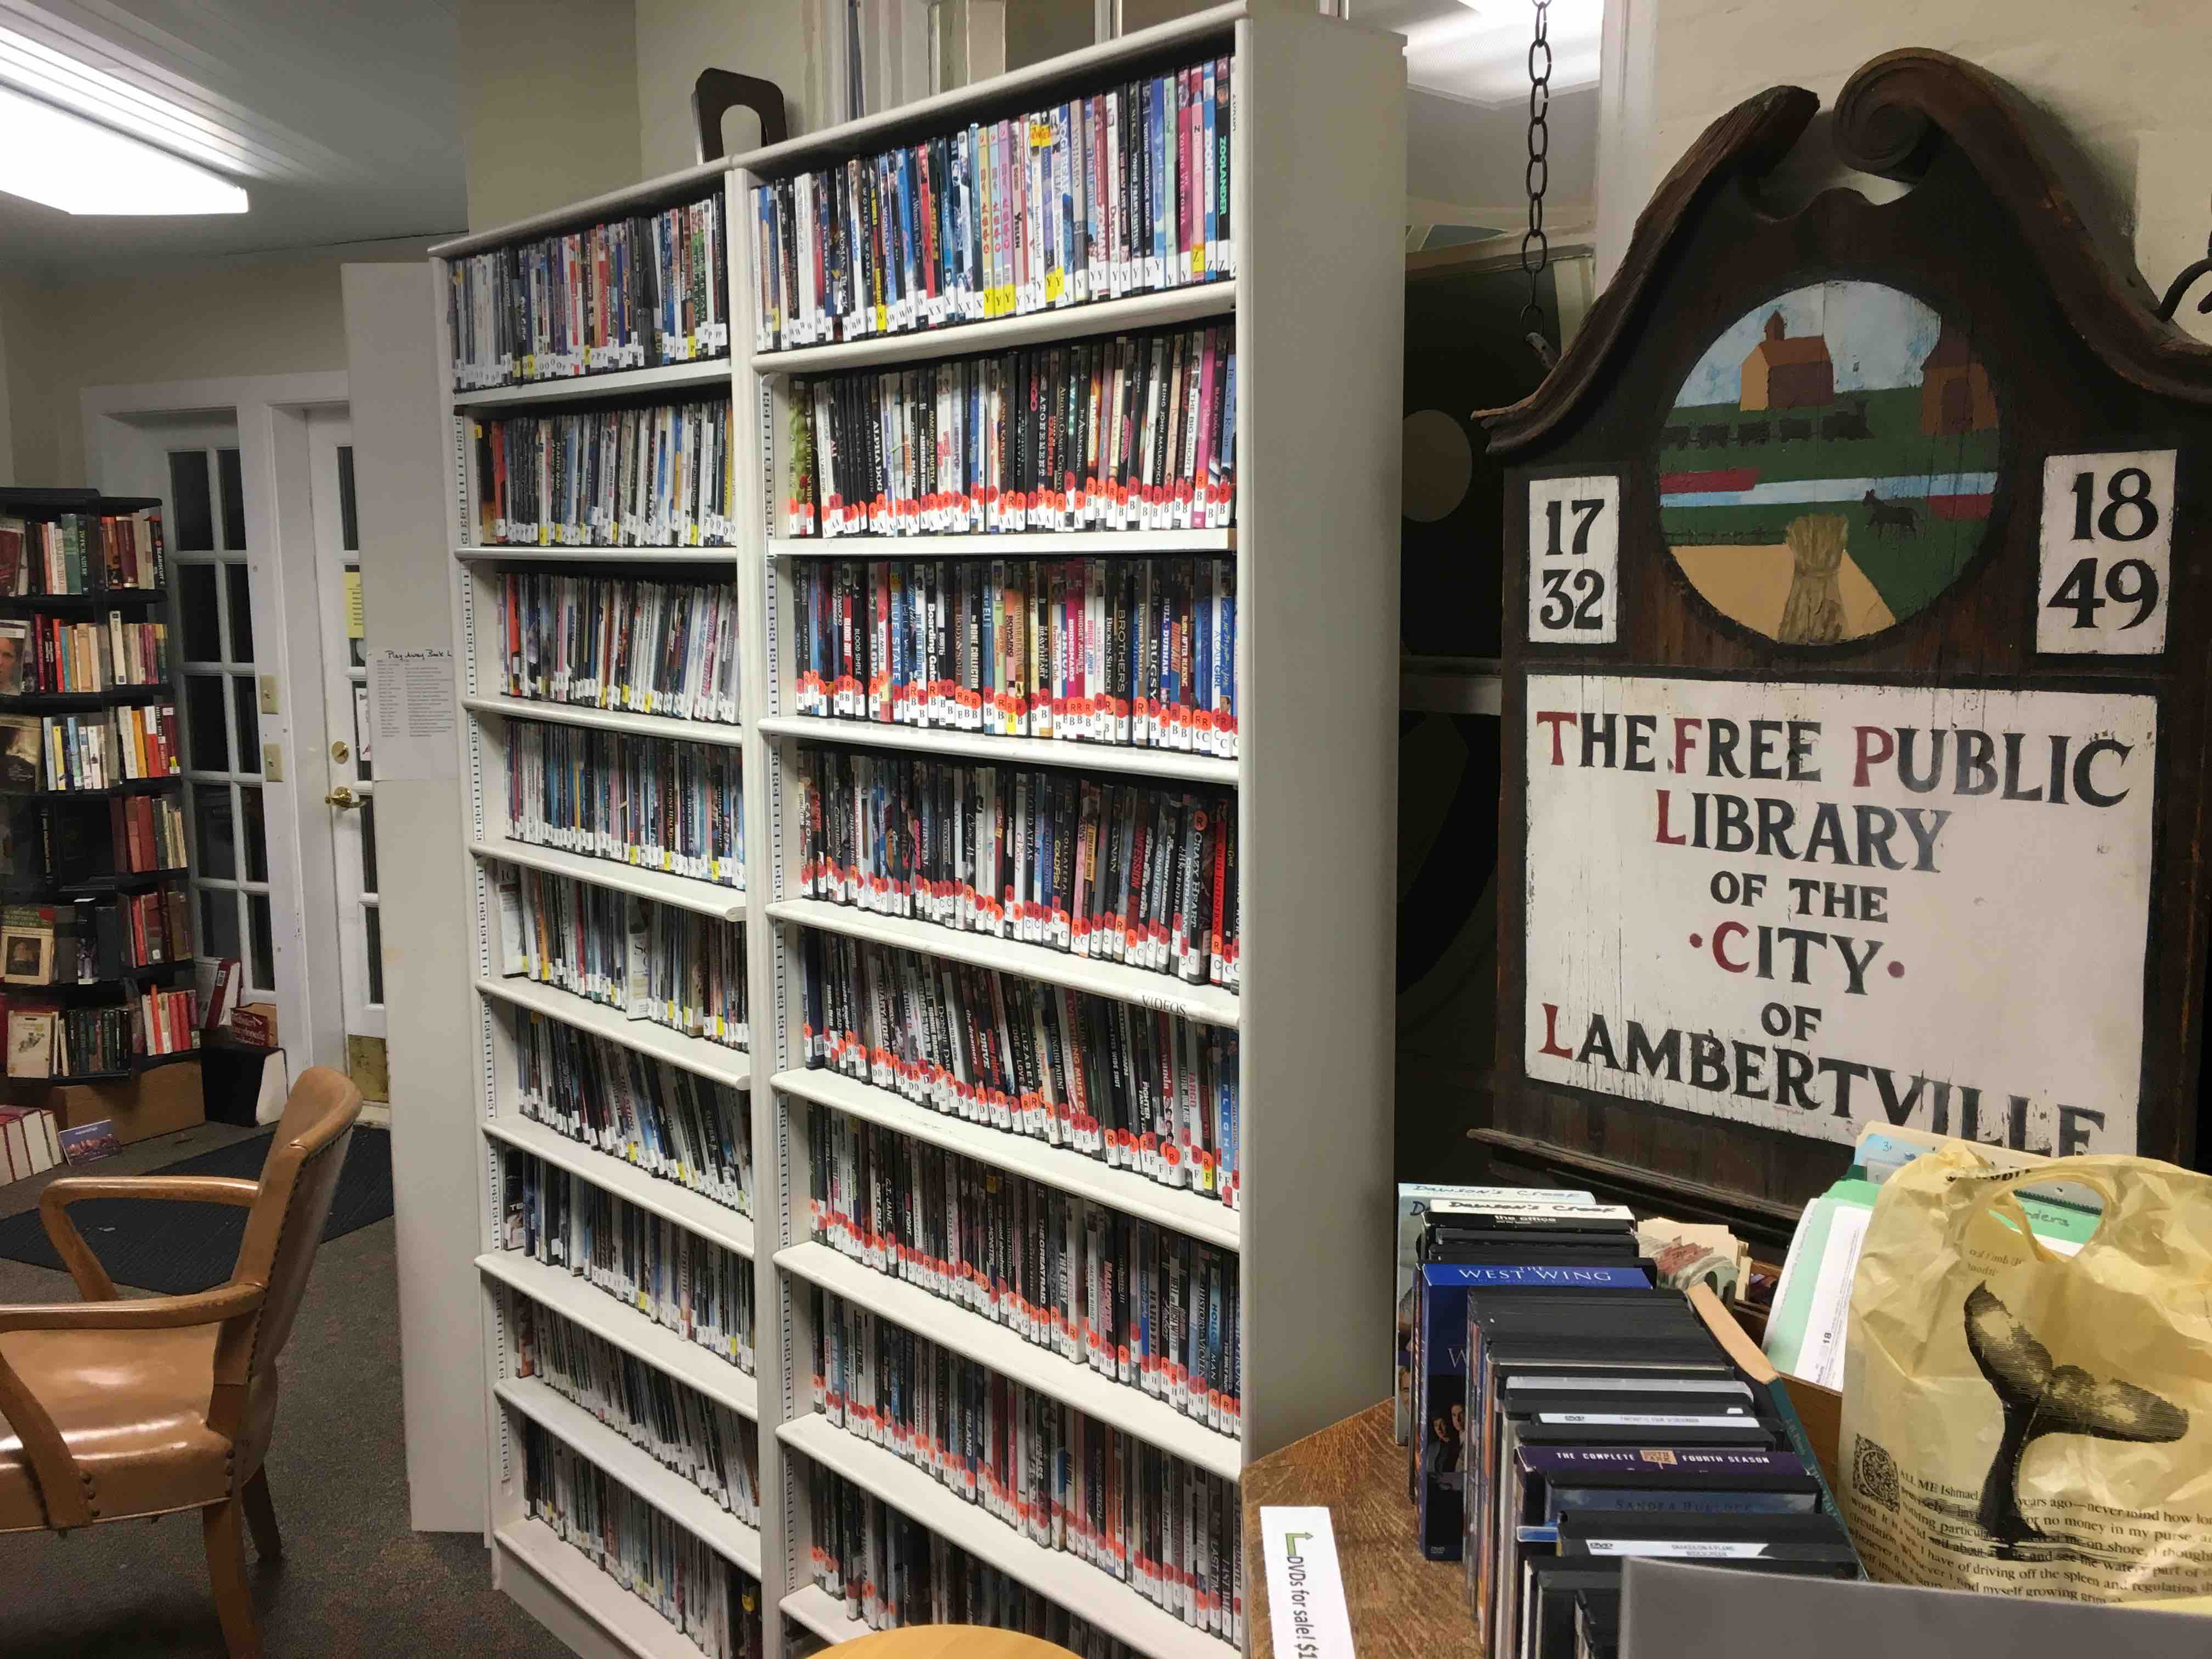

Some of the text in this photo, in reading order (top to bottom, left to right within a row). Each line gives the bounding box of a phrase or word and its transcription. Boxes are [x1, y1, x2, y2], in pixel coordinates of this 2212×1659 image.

[1218, 136, 1227, 216] ZOOLANDER
[1068, 375, 1076, 436] AWAKE
[873, 420, 881, 464] ALPHA
[1038, 396, 1047, 476] ATONEMENT
[1154, 435, 1164, 485] MALKOVICH
[1184, 437, 1194, 472] SHORT
[1545, 499, 1604, 555] 17
[2070, 467, 2159, 542] 18
[1540, 569, 1604, 630] 32
[2046, 558, 2159, 630] 49
[891, 591, 901, 681] BLUE STATE
[928, 603, 937, 681] Boarding Gate
[1117, 609, 1126, 693] BROTHERS
[970, 646, 979, 689] COLLECTOR
[1149, 639, 1158, 700] BUGSY
[1537, 712, 2135, 806] THE FREE PUBLIC
[1655, 789, 1952, 873] LIBRARY
[1062, 830, 1070, 897] COLLATERAL
[1191, 832, 1203, 928] CRAZY HEART
[1182, 857, 1192, 938] CONTRABAND
[1710, 871, 1889, 924] OF THE
[1142, 995, 1187, 1015] VIDEOS
[1761, 1001, 1822, 1042] OF
[968, 1026, 978, 1065] dreamers
[979, 1031, 990, 1069] DRIVE
[1017, 1059, 1025, 1085] LOVE
[1055, 1064, 1064, 1090] PATIENT
[1142, 1081, 1150, 1120] FIGHTER
[1222, 1084, 1231, 1162] FLIGHT
[1458, 1269, 1612, 1281] WEST WING
[1918, 1480, 1939, 1493] ME
[2064, 1518, 2106, 1533] money
[2111, 1525, 2124, 1534] in
[2129, 1527, 2149, 1541] my
[1287, 1556, 1306, 1587] DVDs
[1957, 1562, 1972, 1573] of
[1973, 1564, 2015, 1581] driving
[2040, 1569, 2058, 1579] the
[2063, 1571, 2100, 1588] spleen
[2026, 1587, 2078, 1600] growing
[1292, 1589, 1310, 1607] for
[1294, 1610, 1316, 1640] sale!
